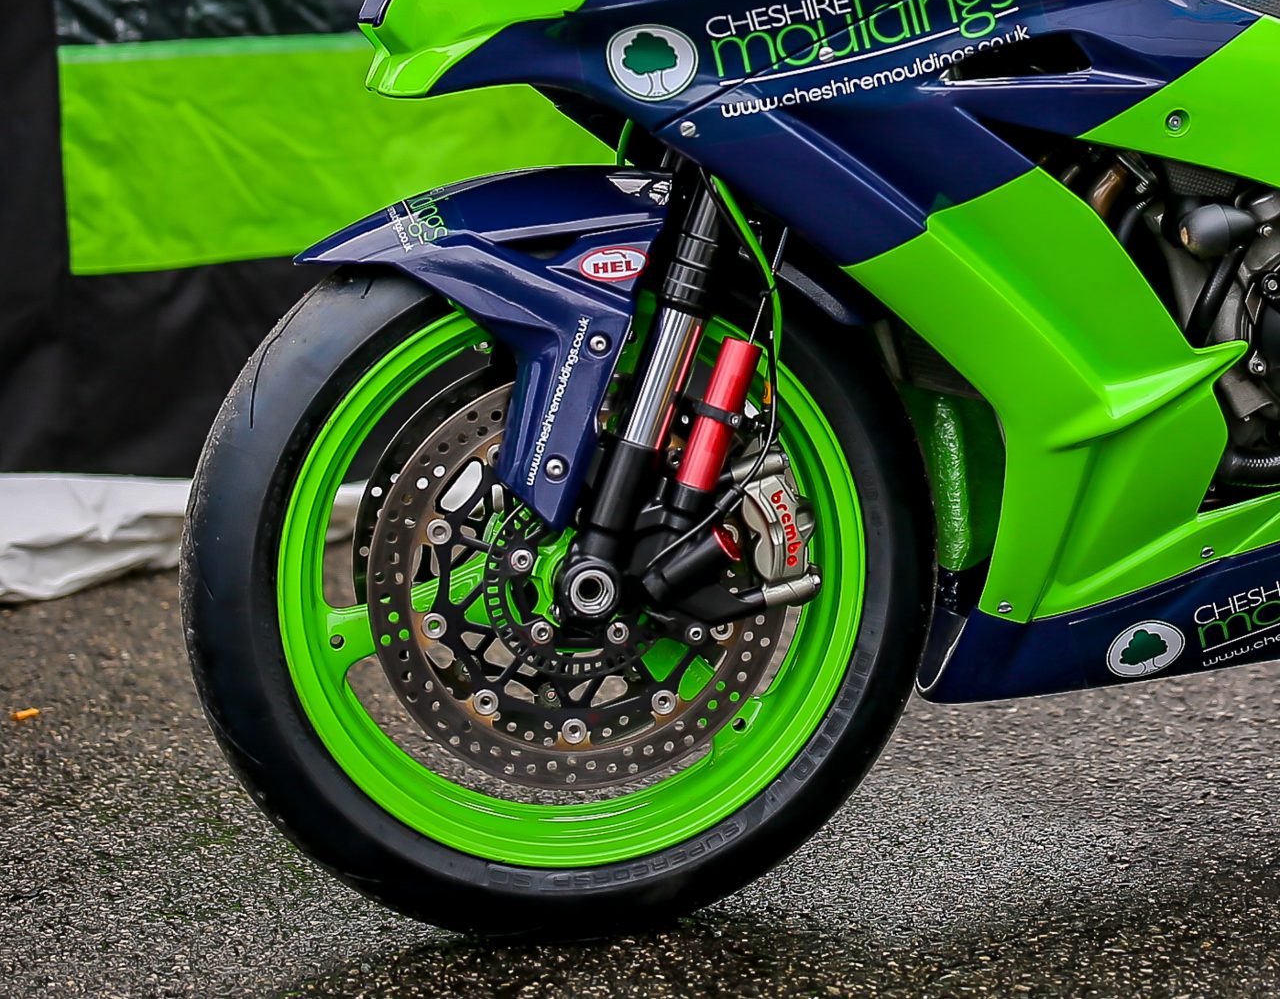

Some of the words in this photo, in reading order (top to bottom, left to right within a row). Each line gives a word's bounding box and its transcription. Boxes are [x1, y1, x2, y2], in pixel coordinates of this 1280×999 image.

[720, 23, 1031, 119] www.cheshiremouldingscouk
[593, 260, 639, 274] HEL
[526, 315, 591, 487] www.cheshiremouldings.co.uk
[770, 489, 803, 567] brembo
